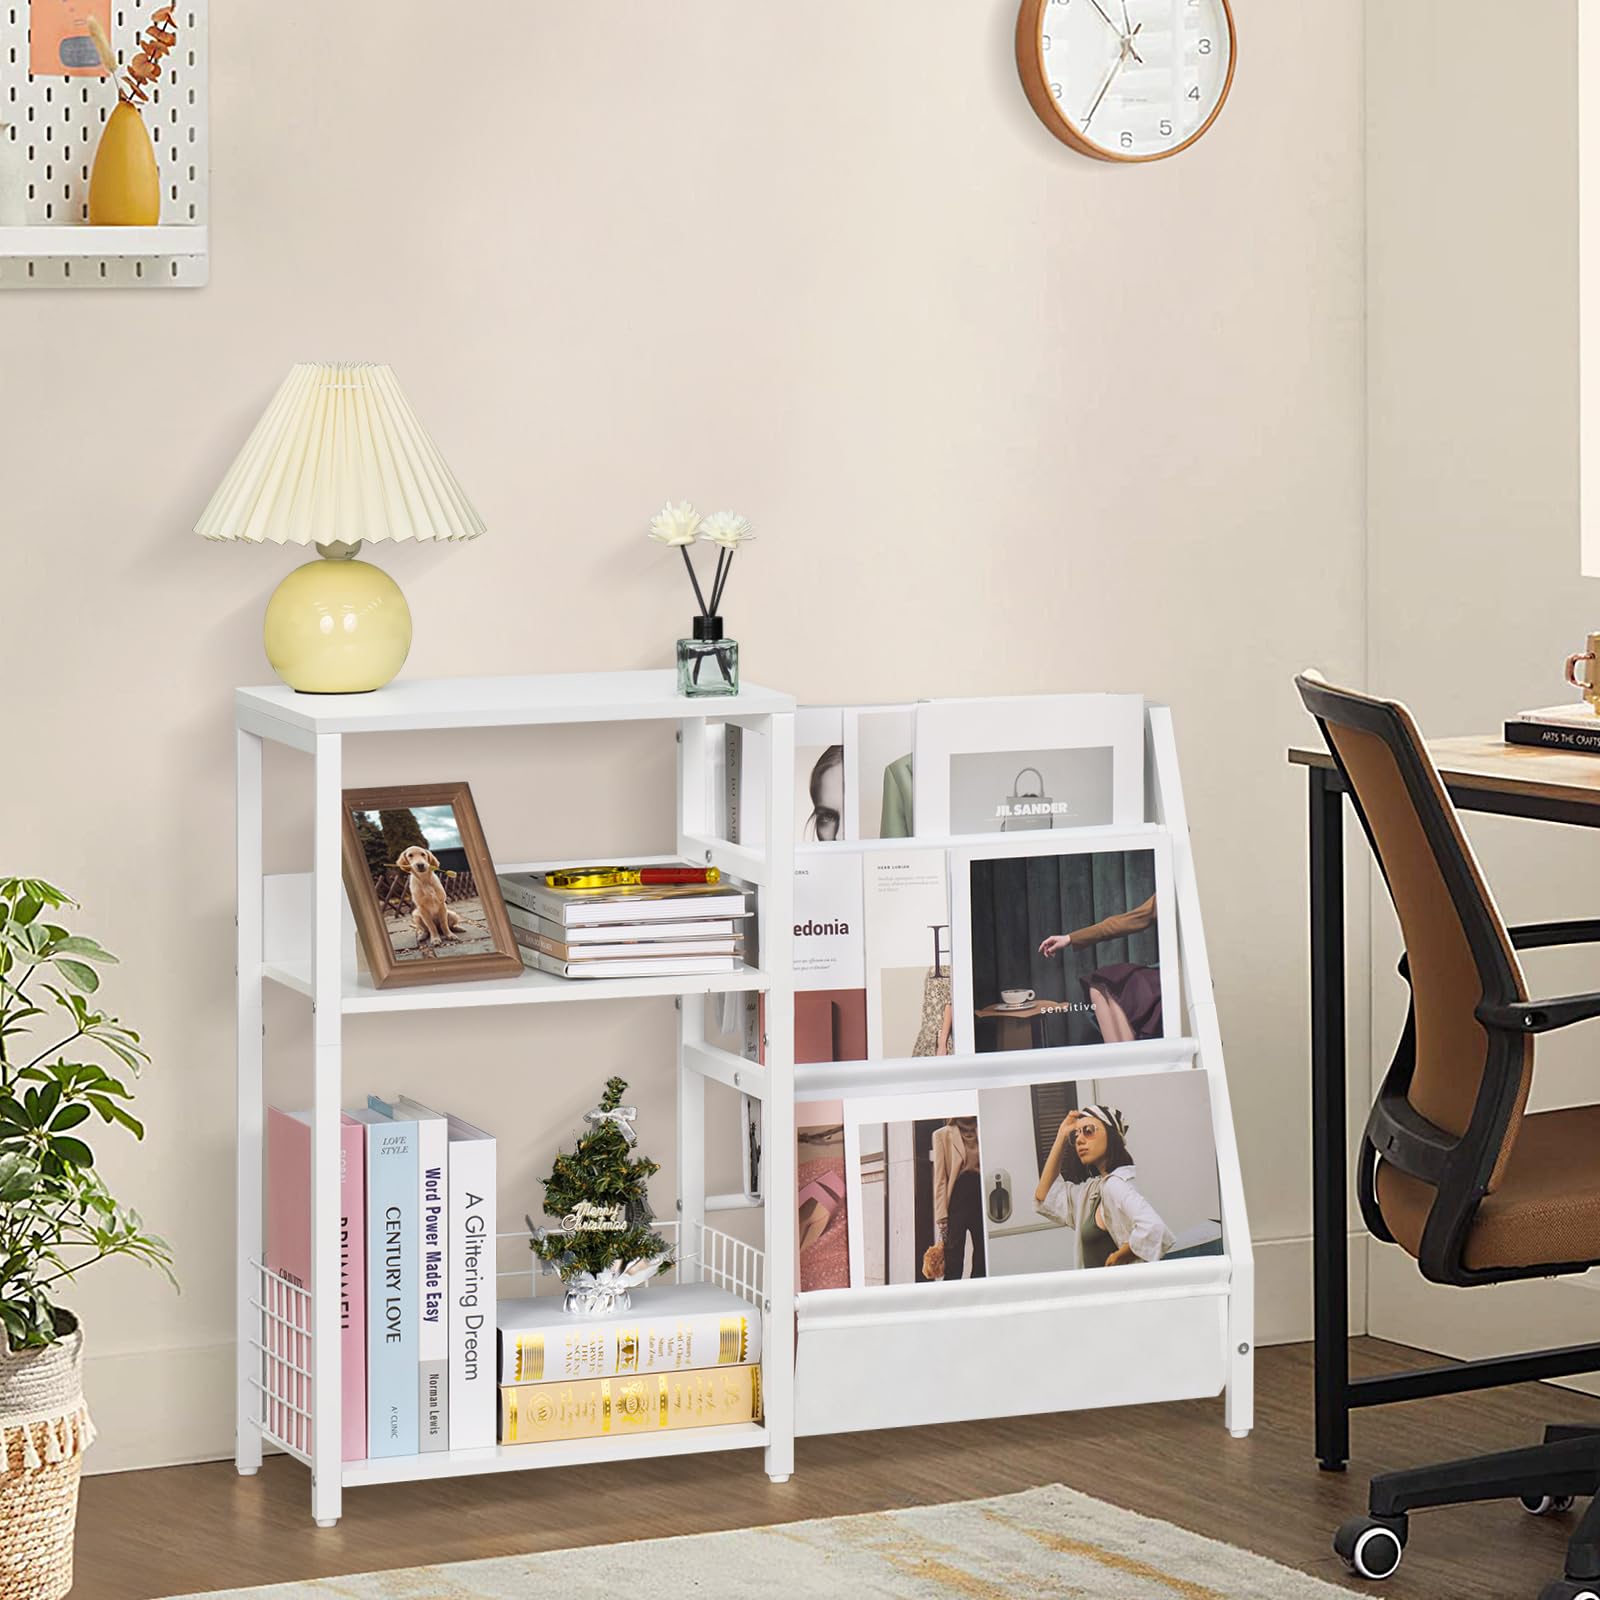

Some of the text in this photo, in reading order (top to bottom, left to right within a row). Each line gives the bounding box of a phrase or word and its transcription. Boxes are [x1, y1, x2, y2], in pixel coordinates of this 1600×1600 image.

[1198, 38, 1212, 55] 3
[1187, 86, 1201, 101] 4
[1159, 119, 1173, 136] 5
[1119, 131, 1133, 148] 6
[1542, 731, 1559, 743] ARTS
[1561, 732, 1574, 744] THE
[1014, 802, 1068, 816] SANDER
[793, 918, 850, 936] edonia
[1040, 1002, 1097, 1014] sensitive
[382, 1136, 407, 1146] LOVE
[380, 1146, 409, 1155] STYLE
[423, 1167, 442, 1324] Word Power Made Easy
[385, 1206, 402, 1344] CENTURY LOVE
[459, 1192, 487, 1381] A Glittering Dream
[429, 1374, 440, 1435] Norman Lewis
